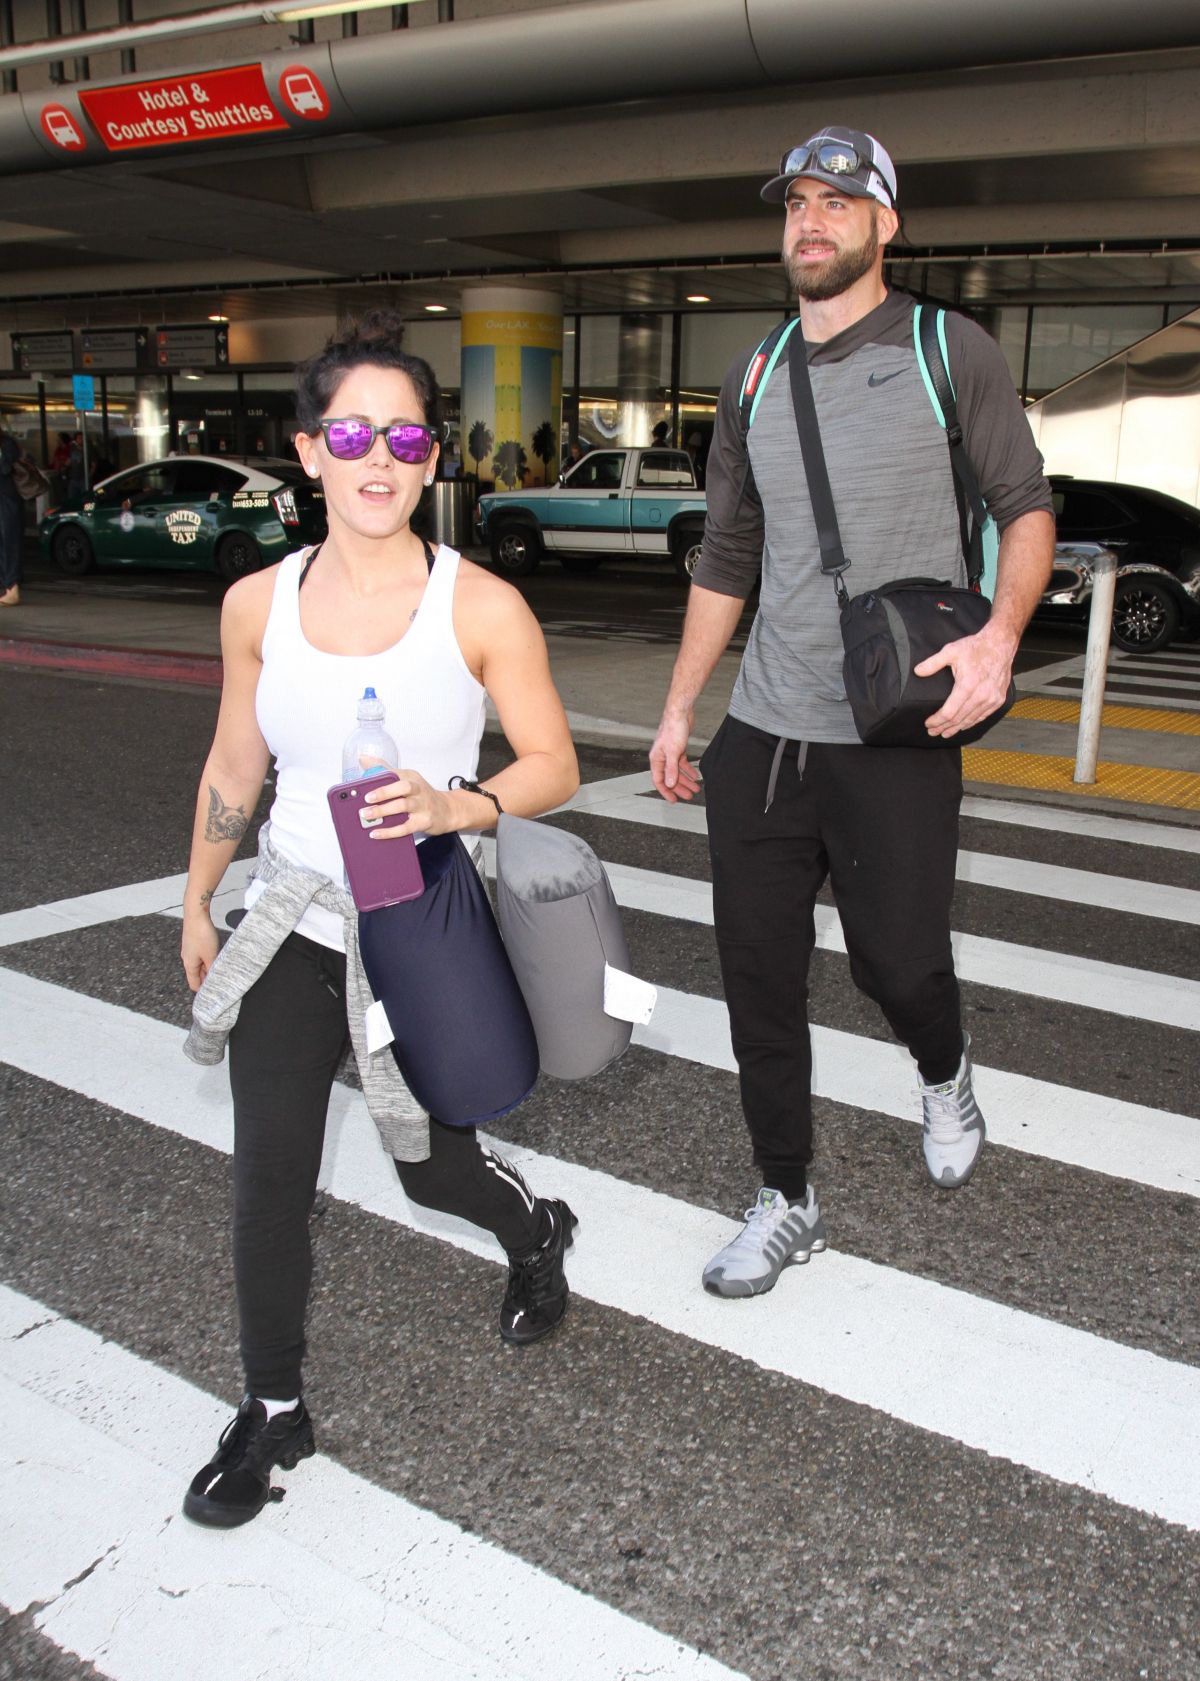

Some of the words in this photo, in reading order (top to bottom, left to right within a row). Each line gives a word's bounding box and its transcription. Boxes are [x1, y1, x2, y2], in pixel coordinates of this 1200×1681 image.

[138, 85, 189, 111] Hotel
[190, 82, 210, 104] &
[107, 117, 188, 141] Courtesy
[190, 103, 273, 130] Shuttles
[165, 510, 201, 526] UNITED
[171, 532, 197, 545] TAXI
